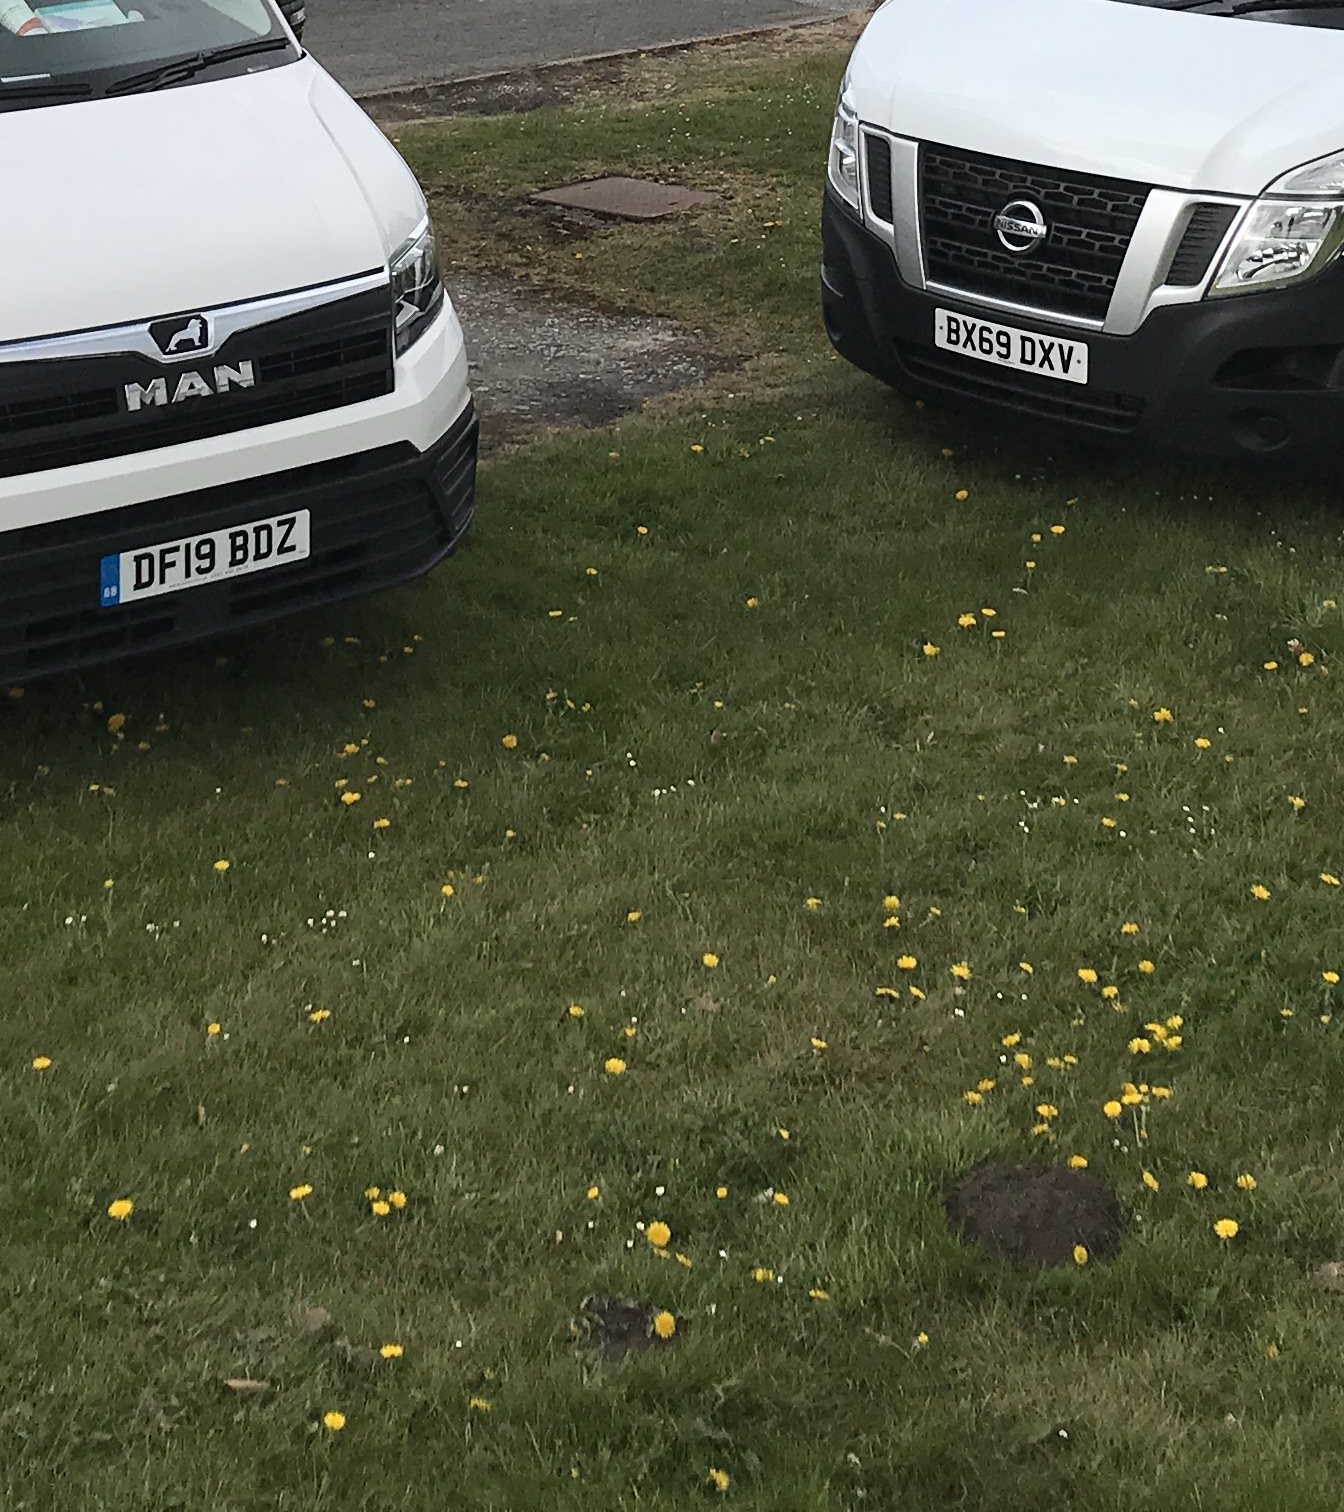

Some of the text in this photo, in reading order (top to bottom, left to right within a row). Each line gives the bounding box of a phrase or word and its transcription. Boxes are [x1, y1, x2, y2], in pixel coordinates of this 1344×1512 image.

[995, 216, 1040, 236] NISSAN
[946, 315, 1074, 375] BX69 DXV
[124, 360, 255, 411] MAN
[132, 536, 217, 592] DF19
[228, 515, 298, 569] BDZ
